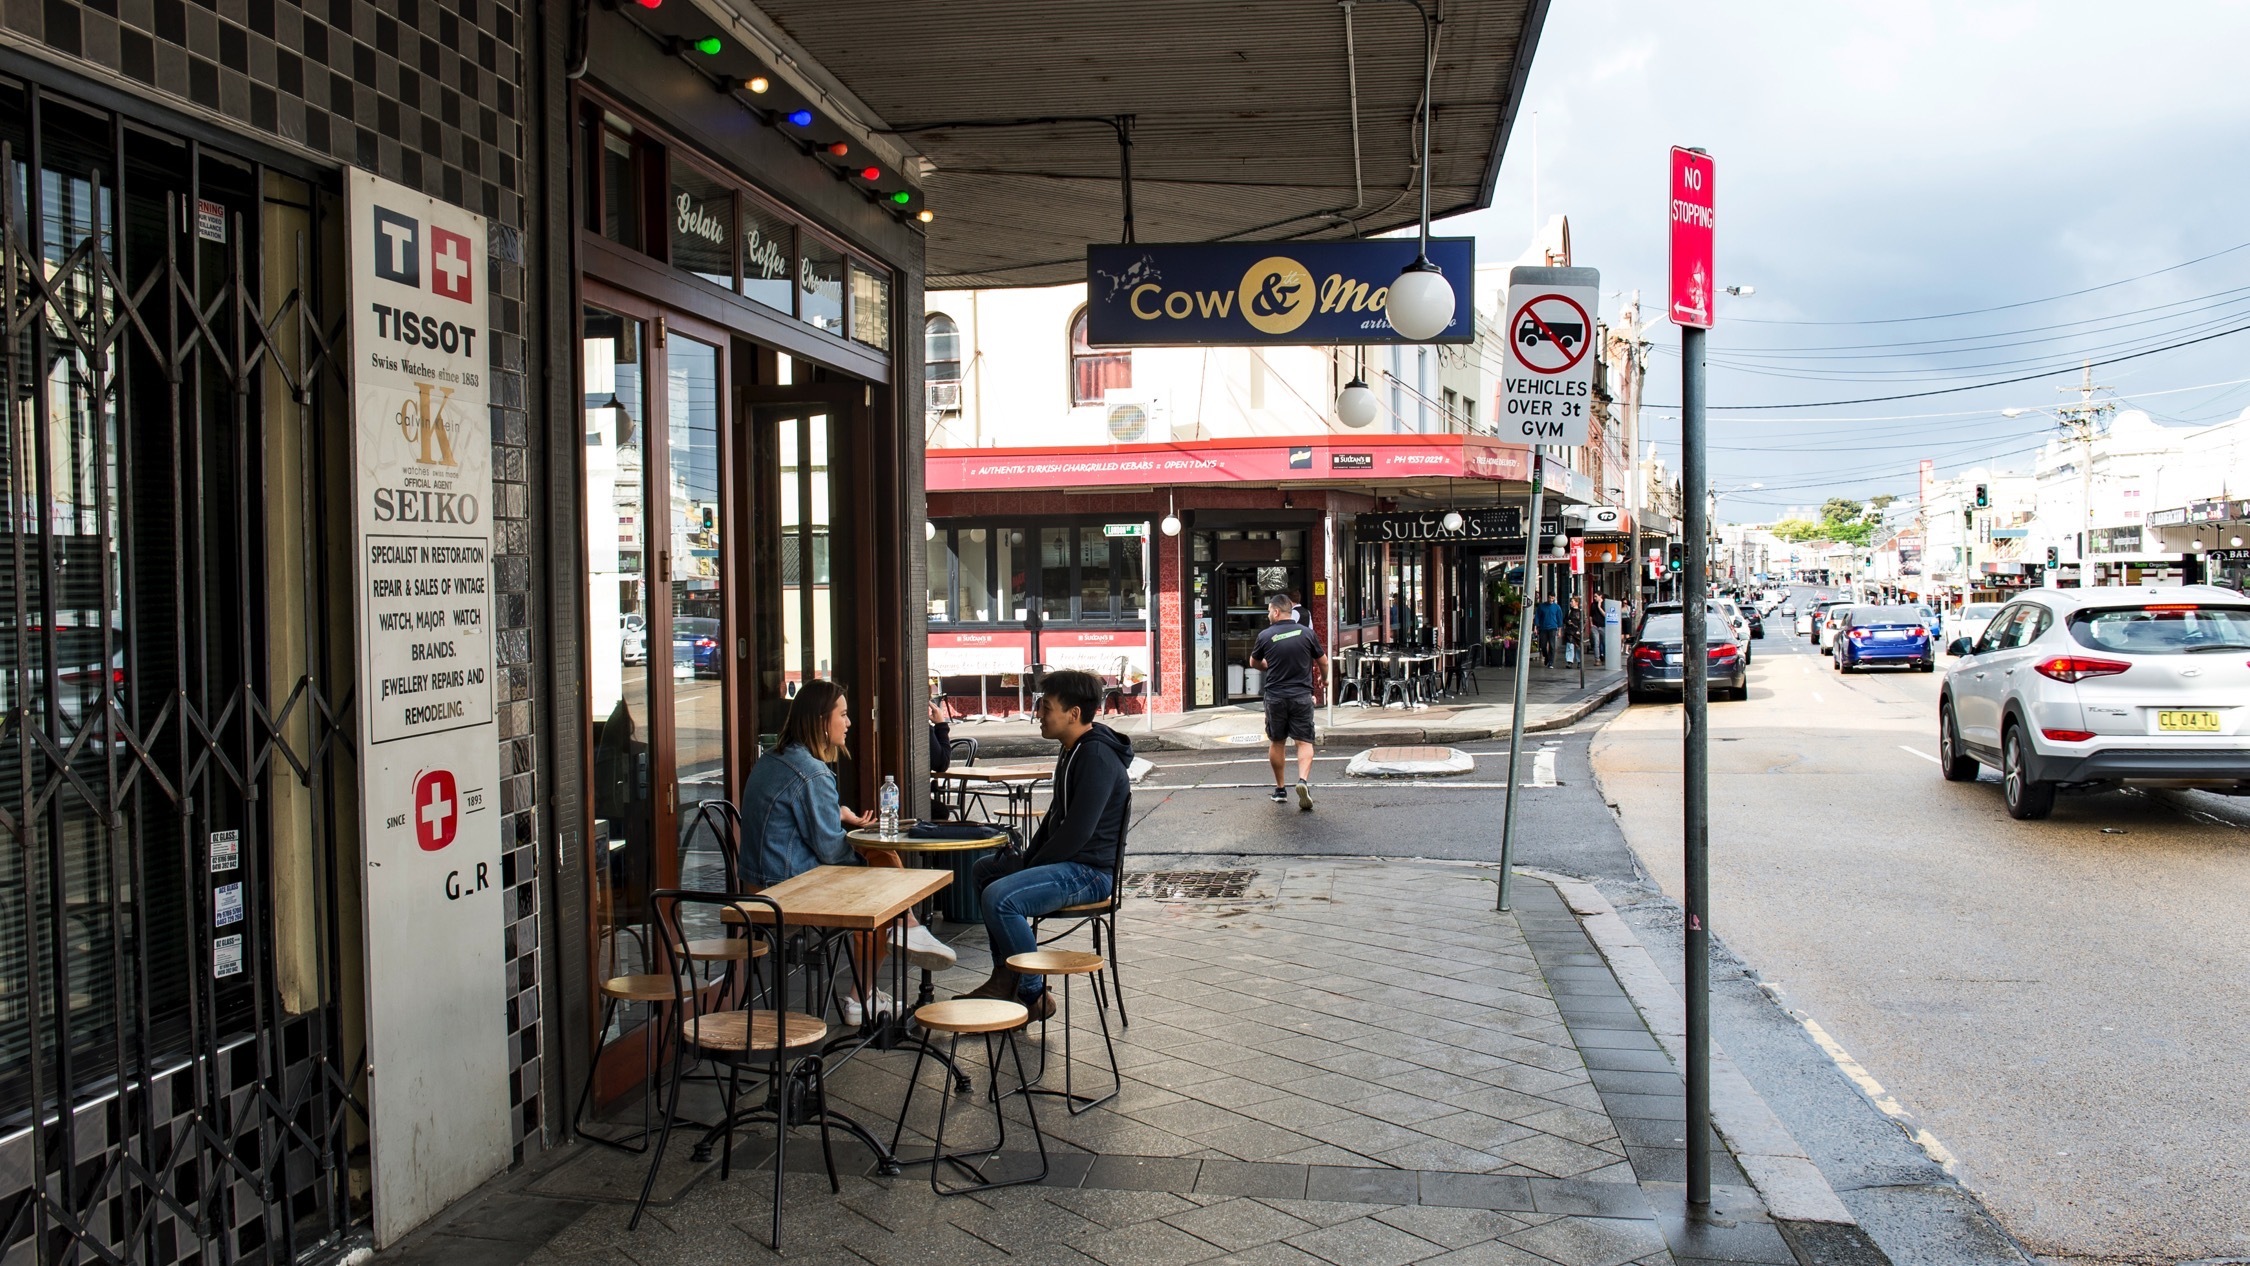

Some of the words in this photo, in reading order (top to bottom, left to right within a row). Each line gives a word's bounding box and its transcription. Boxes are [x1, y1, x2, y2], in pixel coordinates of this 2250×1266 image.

[1684, 166, 1701, 191] NO
[198, 200, 224, 216] RNING
[1673, 199, 1713, 229] STOPPING
[677, 193, 723, 244] Gelato
[748, 230, 785, 280] Coffee
[1130, 284, 1236, 320] Cow
[1251, 273, 1301, 316] &
[1282, 271, 1305, 285] the
[1320, 274, 1388, 314] Mo
[372, 302, 476, 358] TISSOT
[1360, 318, 1392, 330] artis
[372, 353, 398, 371] Swiss
[401, 359, 436, 380] Watches
[438, 368, 459, 384] since
[462, 372, 479, 388] 1853
[1506, 378, 1587, 397] VEHICLES
[1507, 399, 1552, 416] OVER
[1561, 402, 1581, 417] 3t
[396, 412, 431, 430] Calvin
[434, 419, 460, 434] Klein
[1522, 421, 1564, 437] GVM
[402, 466, 429, 476] watches
[978, 465, 1025, 476] AUTHENTIC
[1027, 464, 1062, 473] TURKISH
[1063, 463, 1118, 472] CHARGRILLED
[1120, 461, 1153, 470] KEBABS
[1164, 460, 1188, 469] OPEN
[1190, 460, 1195, 468] 7
[1195, 460, 1217, 468] DAYS
[1486, 457, 1499, 466] HOME
[1499, 458, 1517, 467] DELIVERY
[404, 477, 431, 489] OFFICIAL
[433, 480, 453, 491] AGENT
[373, 486, 479, 525] SEIKO
[372, 546, 417, 563] SPECIALIST
[421, 547, 429, 563] IN
[432, 547, 484, 563] RESTORATION
[373, 579, 402, 597] REPAIR
[406, 579, 411, 596] &
[414, 578, 438, 596] SALES
[441, 578, 451, 595] OF
[454, 578, 485, 594] VINTAGE
[379, 612, 414, 632] WATCH,
[416, 610, 445, 632] MAJOR
[453, 608, 481, 625] WATCH
[412, 641, 456, 661] BRANDS.
[382, 674, 428, 701] JEWELLERY
[432, 670, 464, 690] REPAIRS
[467, 668, 484, 685] AND
[405, 701, 464, 726] REMODELING.
[2161, 712, 2177, 726] CL
[2181, 714, 2196, 725] 04
[2202, 712, 2218, 726] TU
[467, 794, 482, 807] 1893
[387, 814, 406, 829] SINCE
[220, 831, 235, 841] GLASS
[222, 937, 234, 946] GLASS
